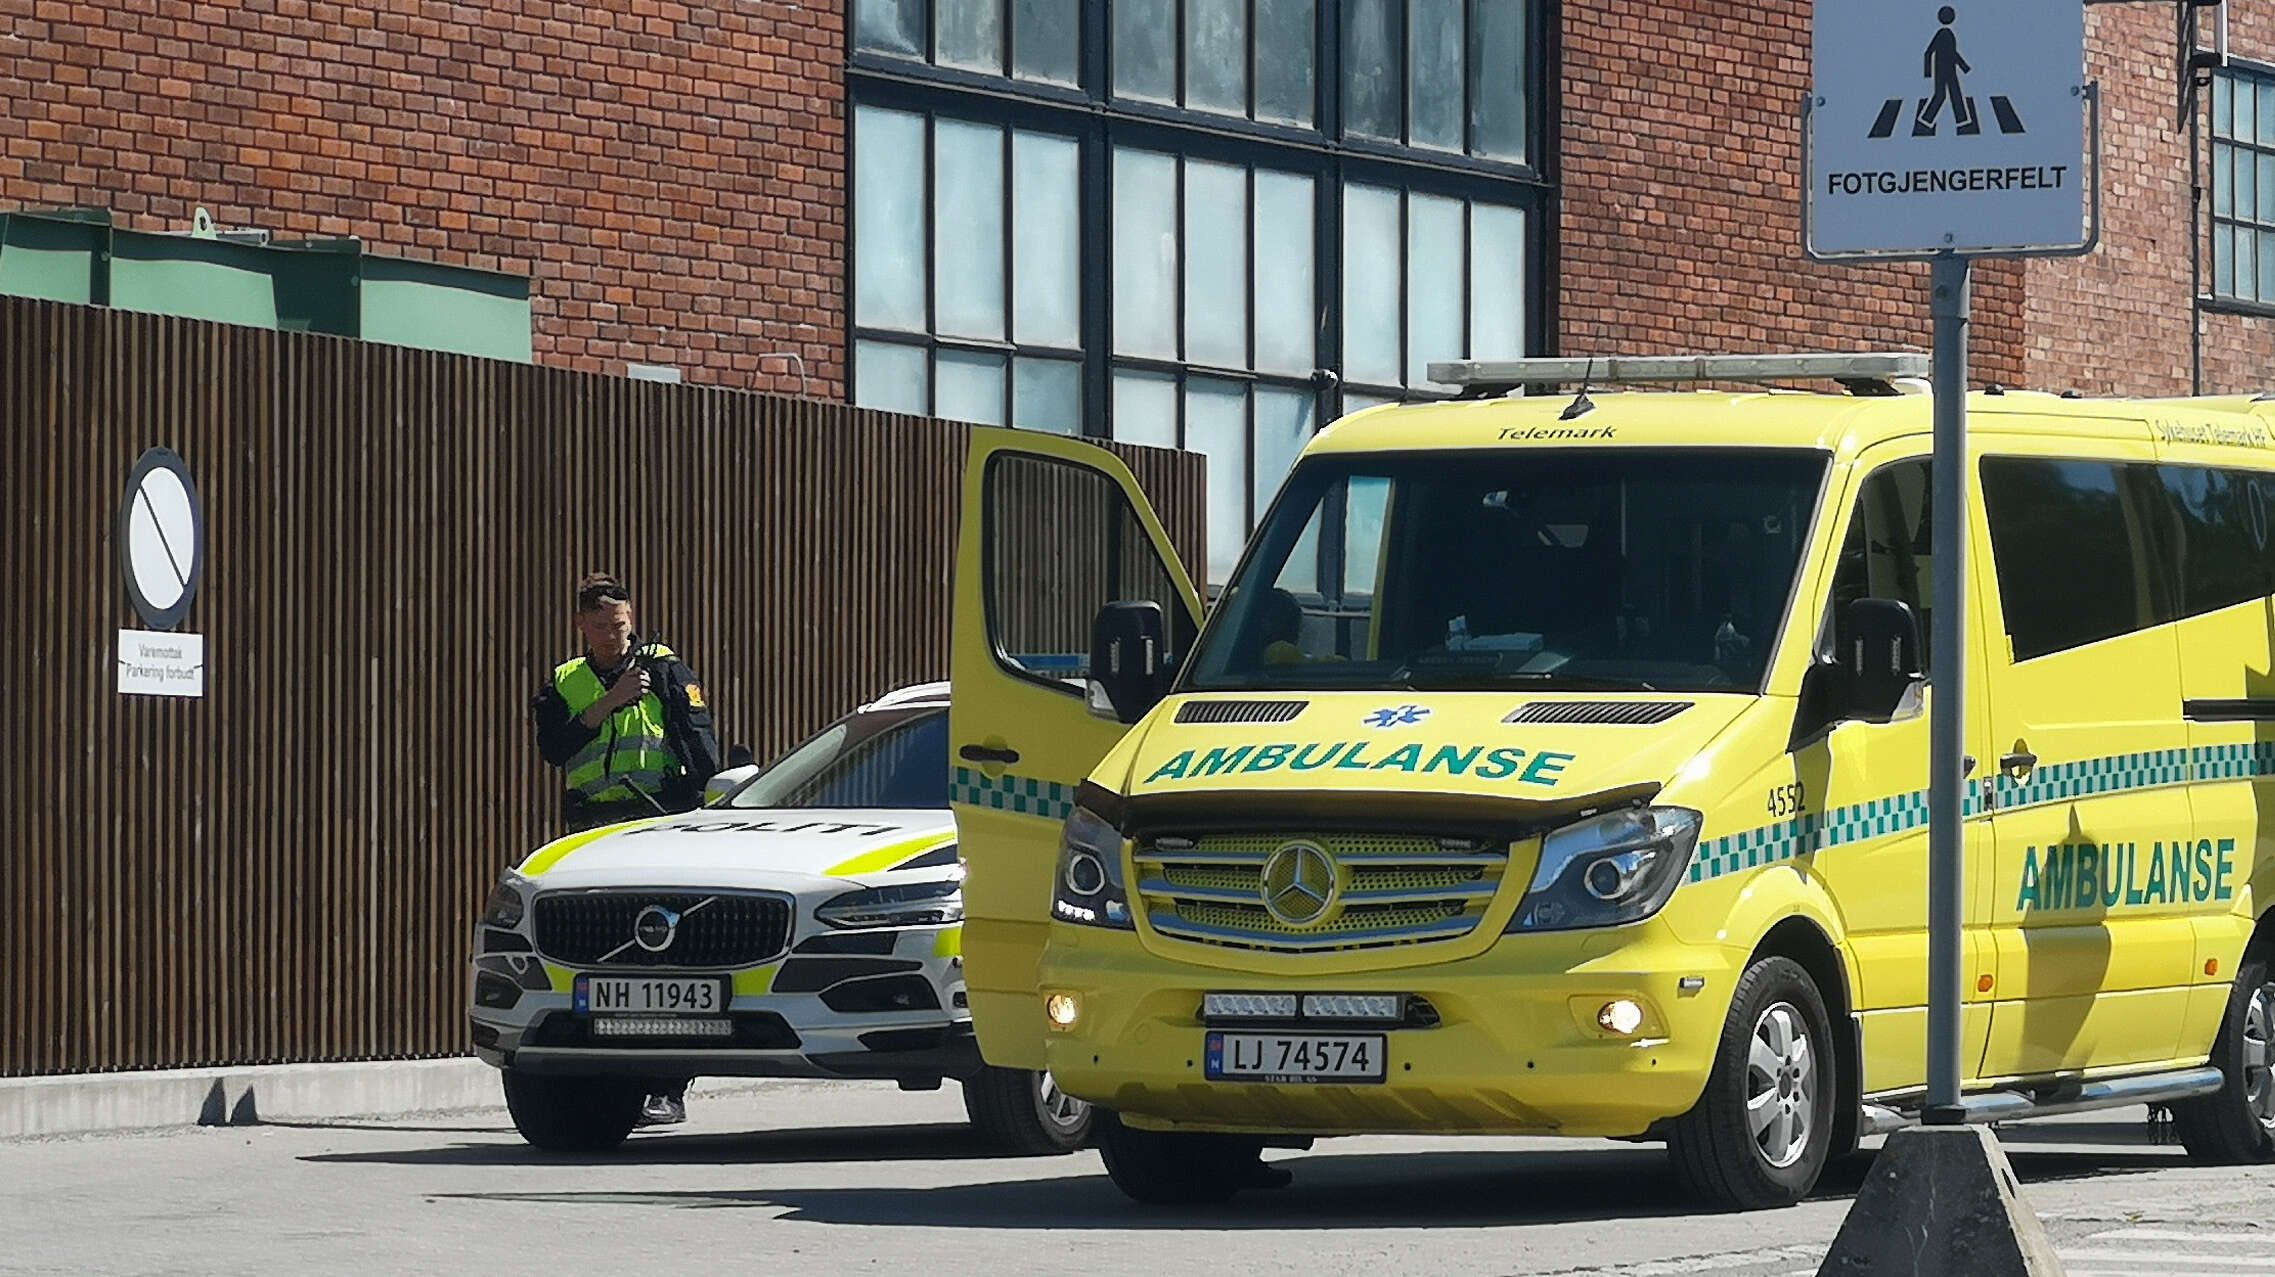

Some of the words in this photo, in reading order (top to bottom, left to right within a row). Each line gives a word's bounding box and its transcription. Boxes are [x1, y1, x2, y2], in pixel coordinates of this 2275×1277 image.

[1828, 166, 2067, 194] FOTGJENGERFELT
[1497, 425, 1617, 440] Telemark
[1143, 741, 1576, 786] AMBULANSE
[1767, 782, 1806, 818] 4552
[622, 821, 902, 837] POLITI
[2016, 837, 2236, 912] AMBULANSE
[596, 982, 630, 1008] NH
[642, 983, 713, 1009] 11943
[1234, 1040, 1264, 1070] LJ
[1277, 1040, 1370, 1072] 74574
